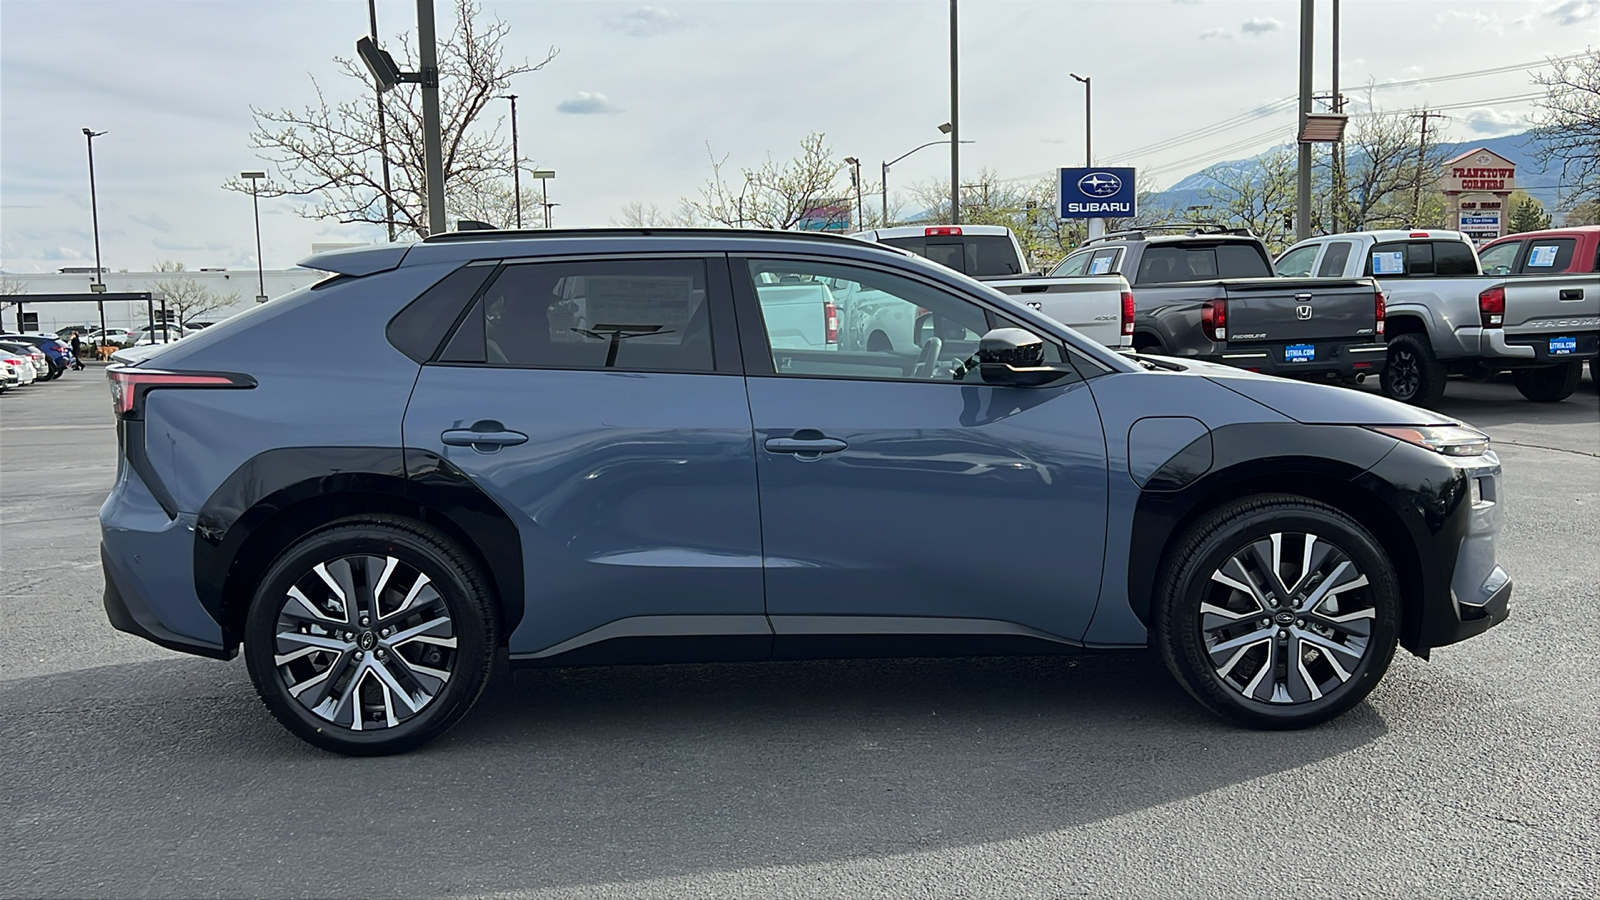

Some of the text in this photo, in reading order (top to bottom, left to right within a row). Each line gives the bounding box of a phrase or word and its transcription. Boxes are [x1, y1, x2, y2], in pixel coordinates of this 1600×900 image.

[1452, 168, 1515, 178] FRANKTOWN
[1461, 179, 1505, 190] CORNERS
[1068, 202, 1130, 213] SUBARU
[1549, 341, 1577, 350] LITHIA.COM
[1285, 348, 1315, 357] LITHIA.COM
